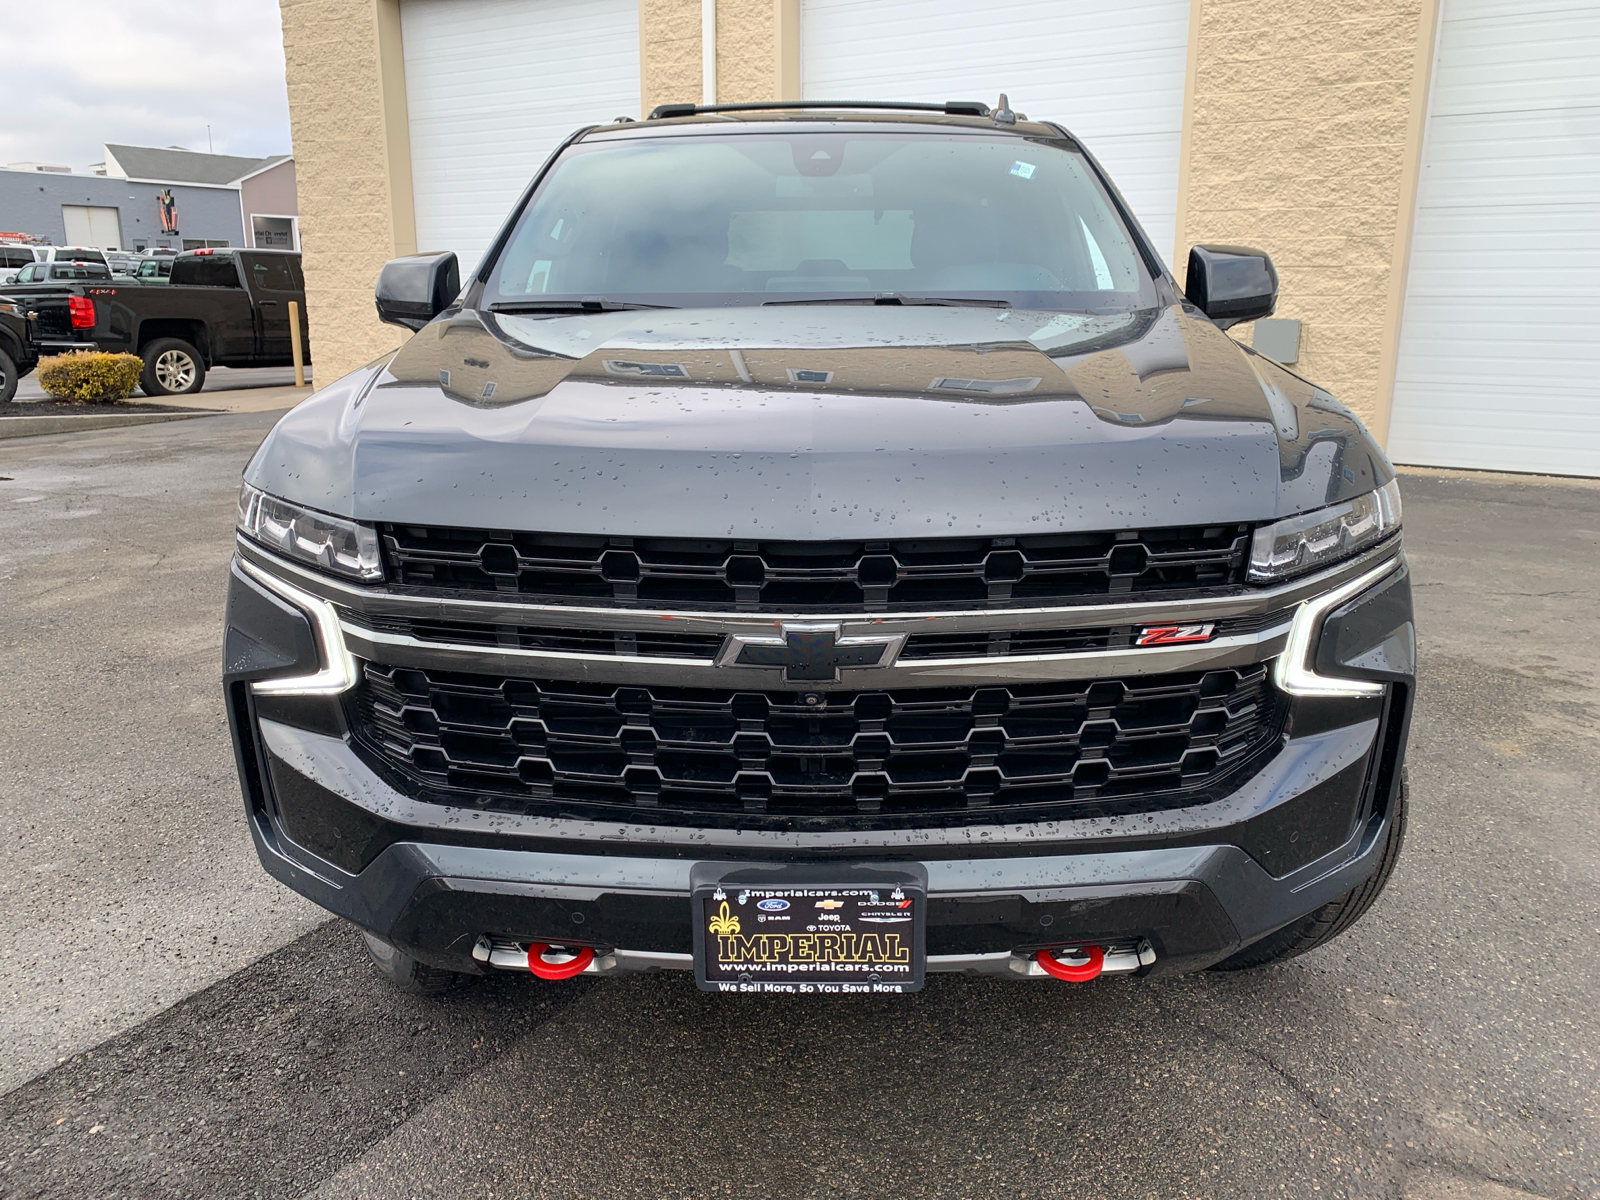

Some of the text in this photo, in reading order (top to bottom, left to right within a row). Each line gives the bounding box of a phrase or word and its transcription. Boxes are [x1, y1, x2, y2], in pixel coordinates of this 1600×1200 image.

[1135, 624, 1215, 645] Z71
[744, 889, 872, 898] Imperialcars.com
[818, 913, 840, 922] Jeep
[718, 933, 909, 962] IMPERIAL
[719, 962, 910, 973] www.imperialcars.com
[719, 983, 902, 994] We Sell More, So You Save More
